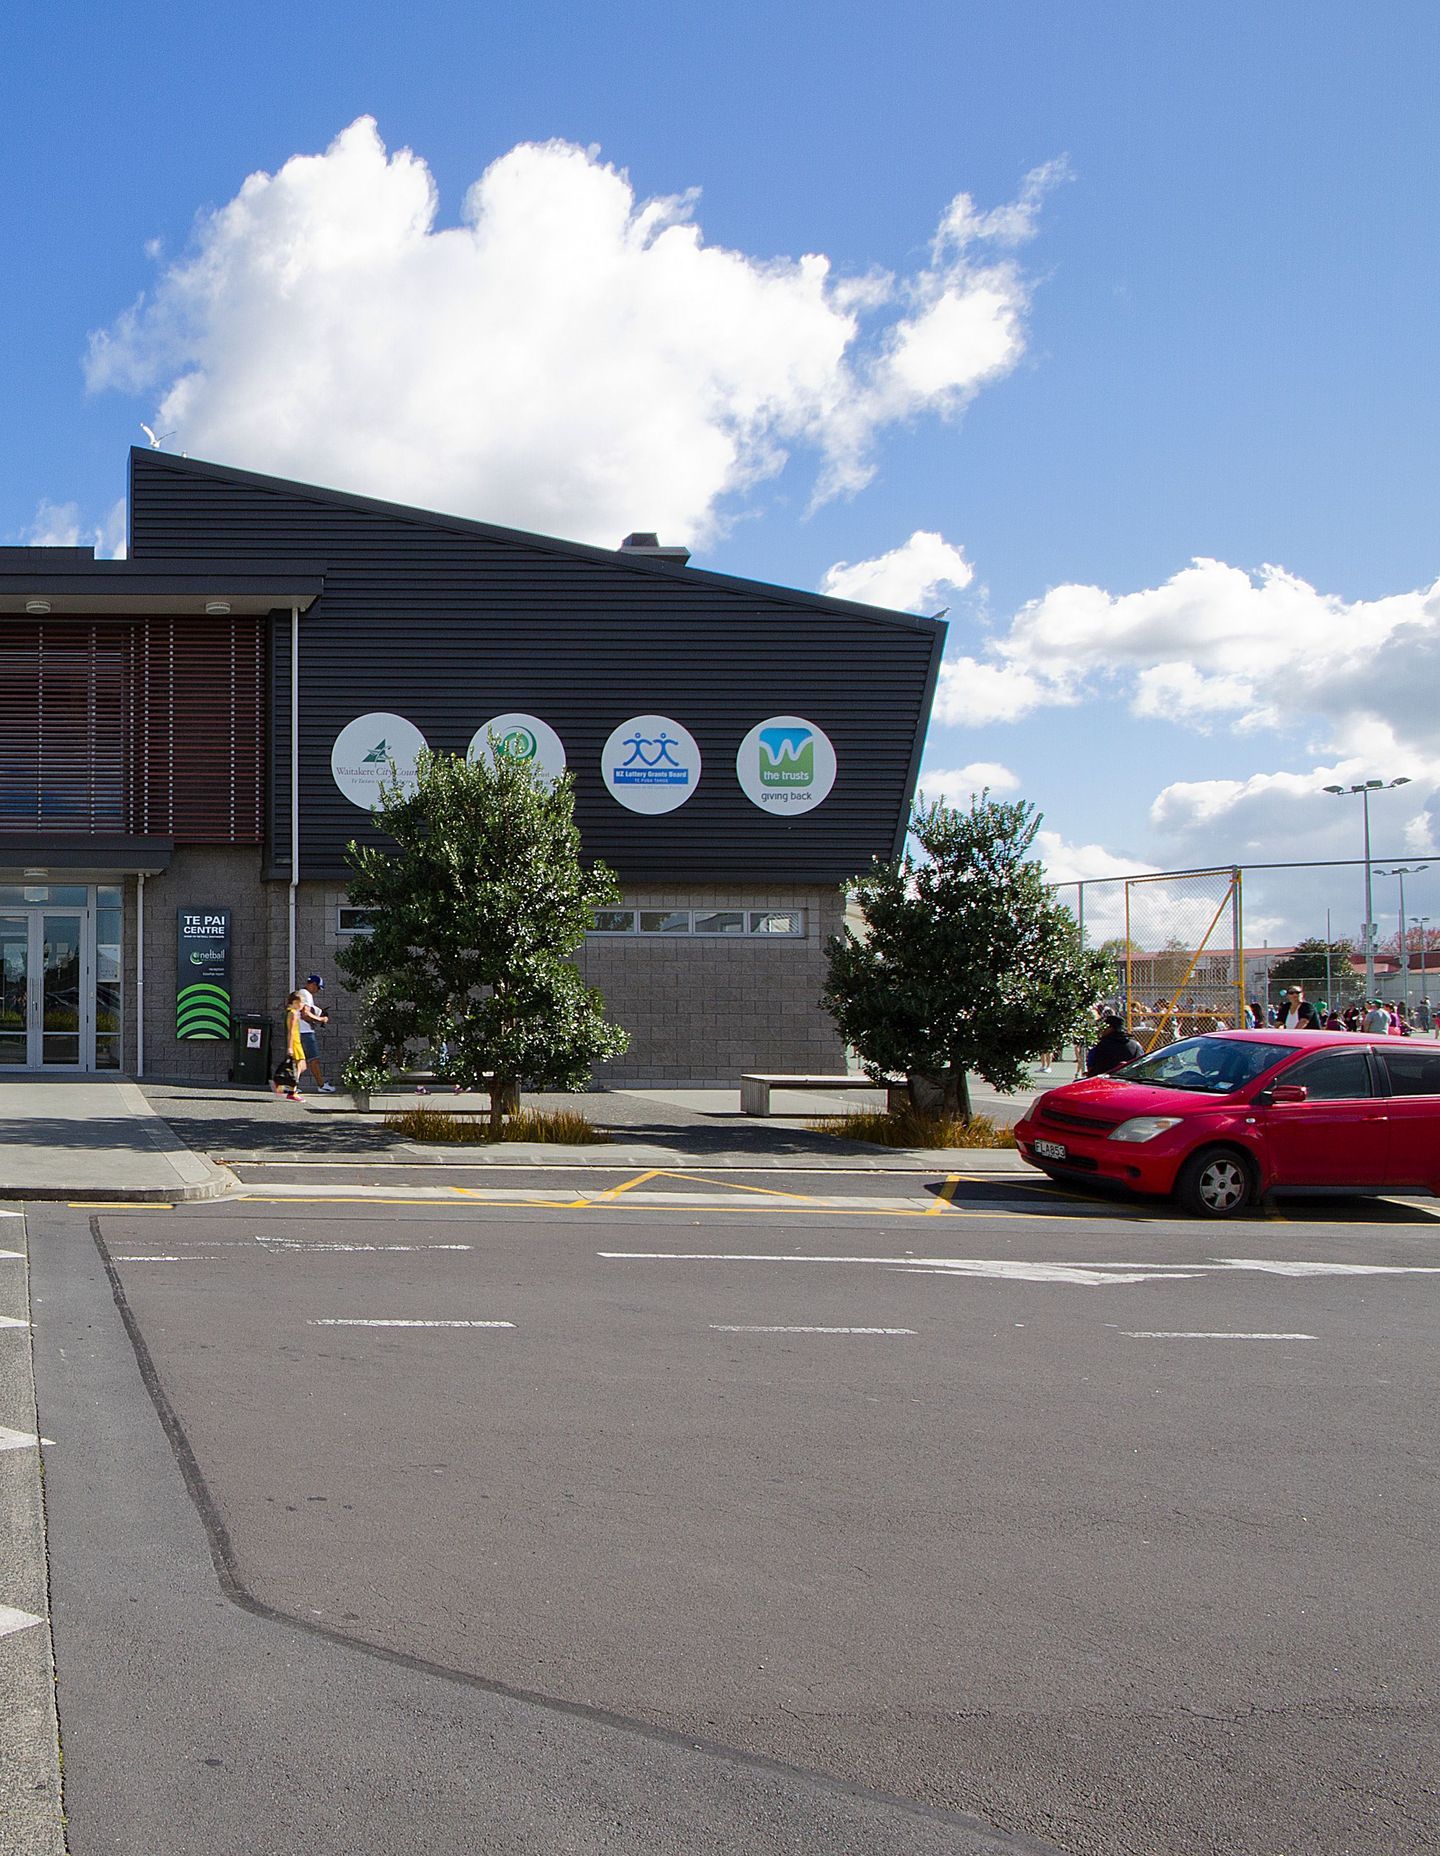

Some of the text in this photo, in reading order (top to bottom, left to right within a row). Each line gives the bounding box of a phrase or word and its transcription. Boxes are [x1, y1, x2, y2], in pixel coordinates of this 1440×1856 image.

[336, 766, 418, 778] Waitakere City Coun
[763, 771, 809, 780] the trusts
[761, 792, 812, 802] giving back
[183, 915, 225, 925] TE PAI
[183, 926, 225, 934] CENTRE
[200, 949, 225, 959] netball
